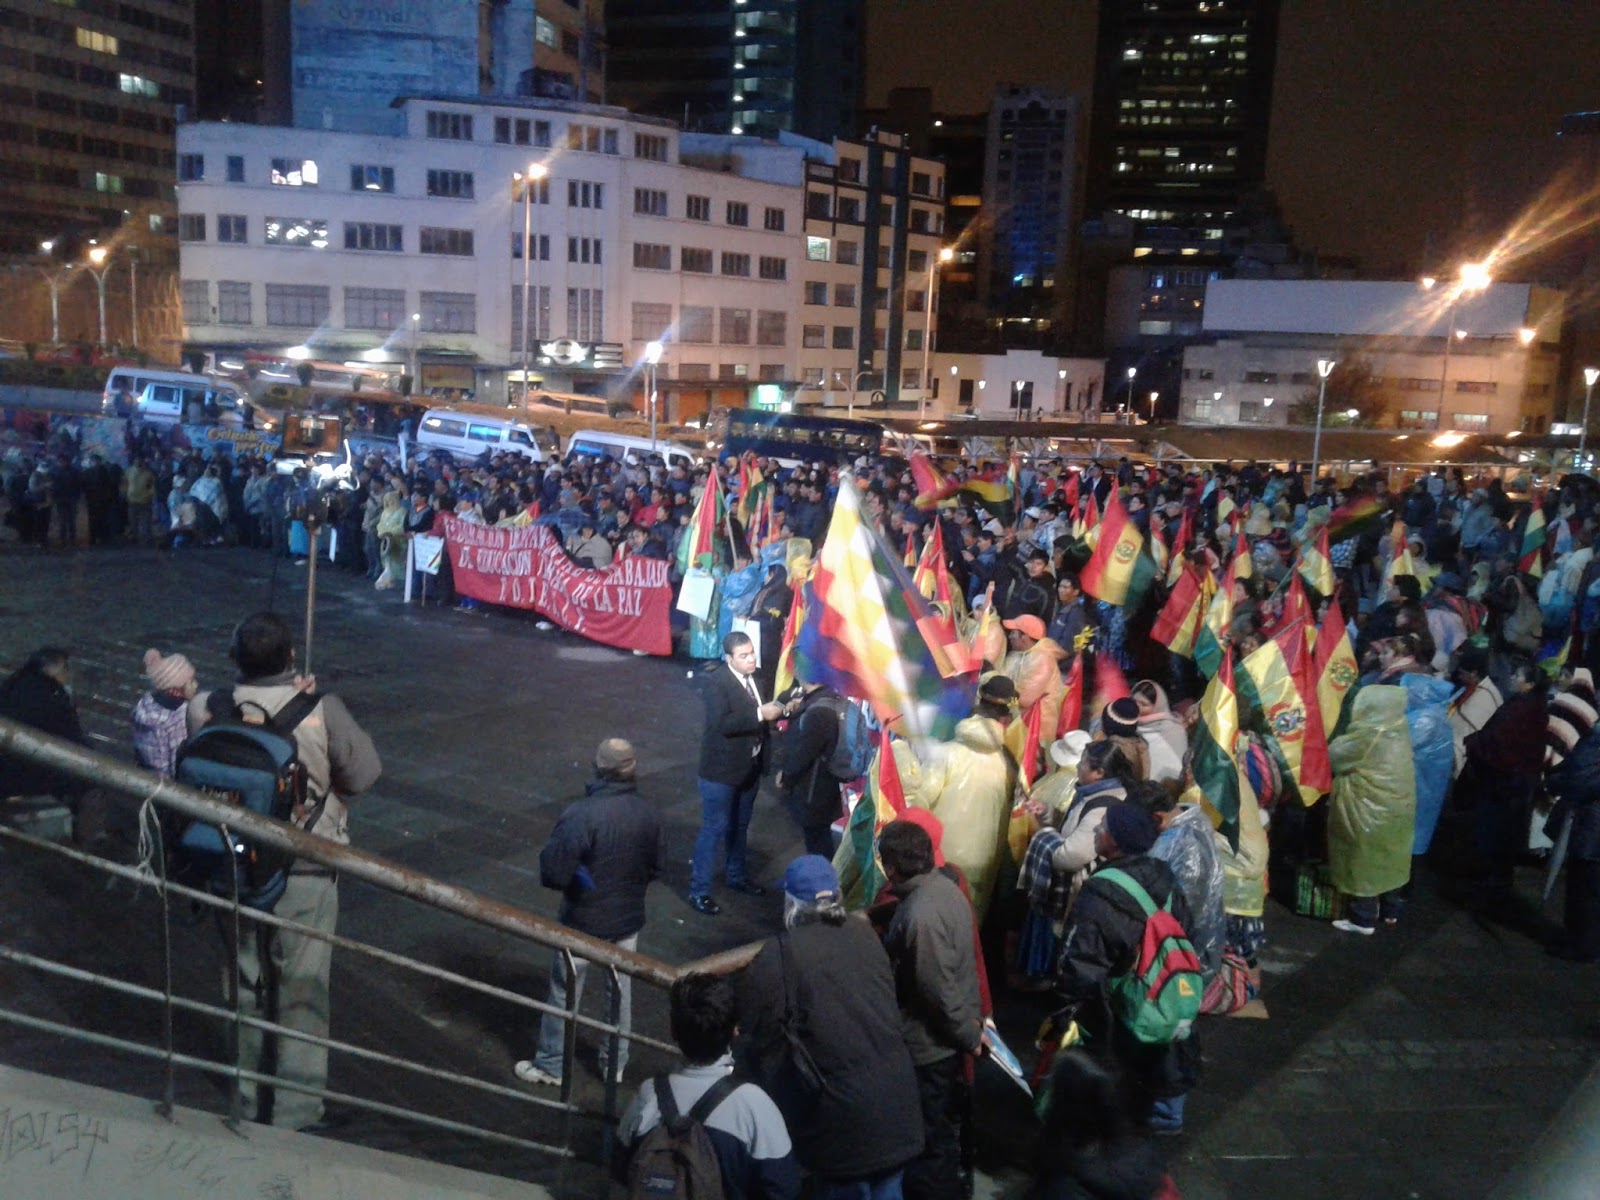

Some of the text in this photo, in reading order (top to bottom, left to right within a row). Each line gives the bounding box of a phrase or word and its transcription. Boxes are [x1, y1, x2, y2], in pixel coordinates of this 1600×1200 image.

[476, 547, 532, 577] EDUCACION
[572, 582, 595, 608] DE
[593, 586, 614, 613] LA
[617, 587, 643, 617] PAZ
